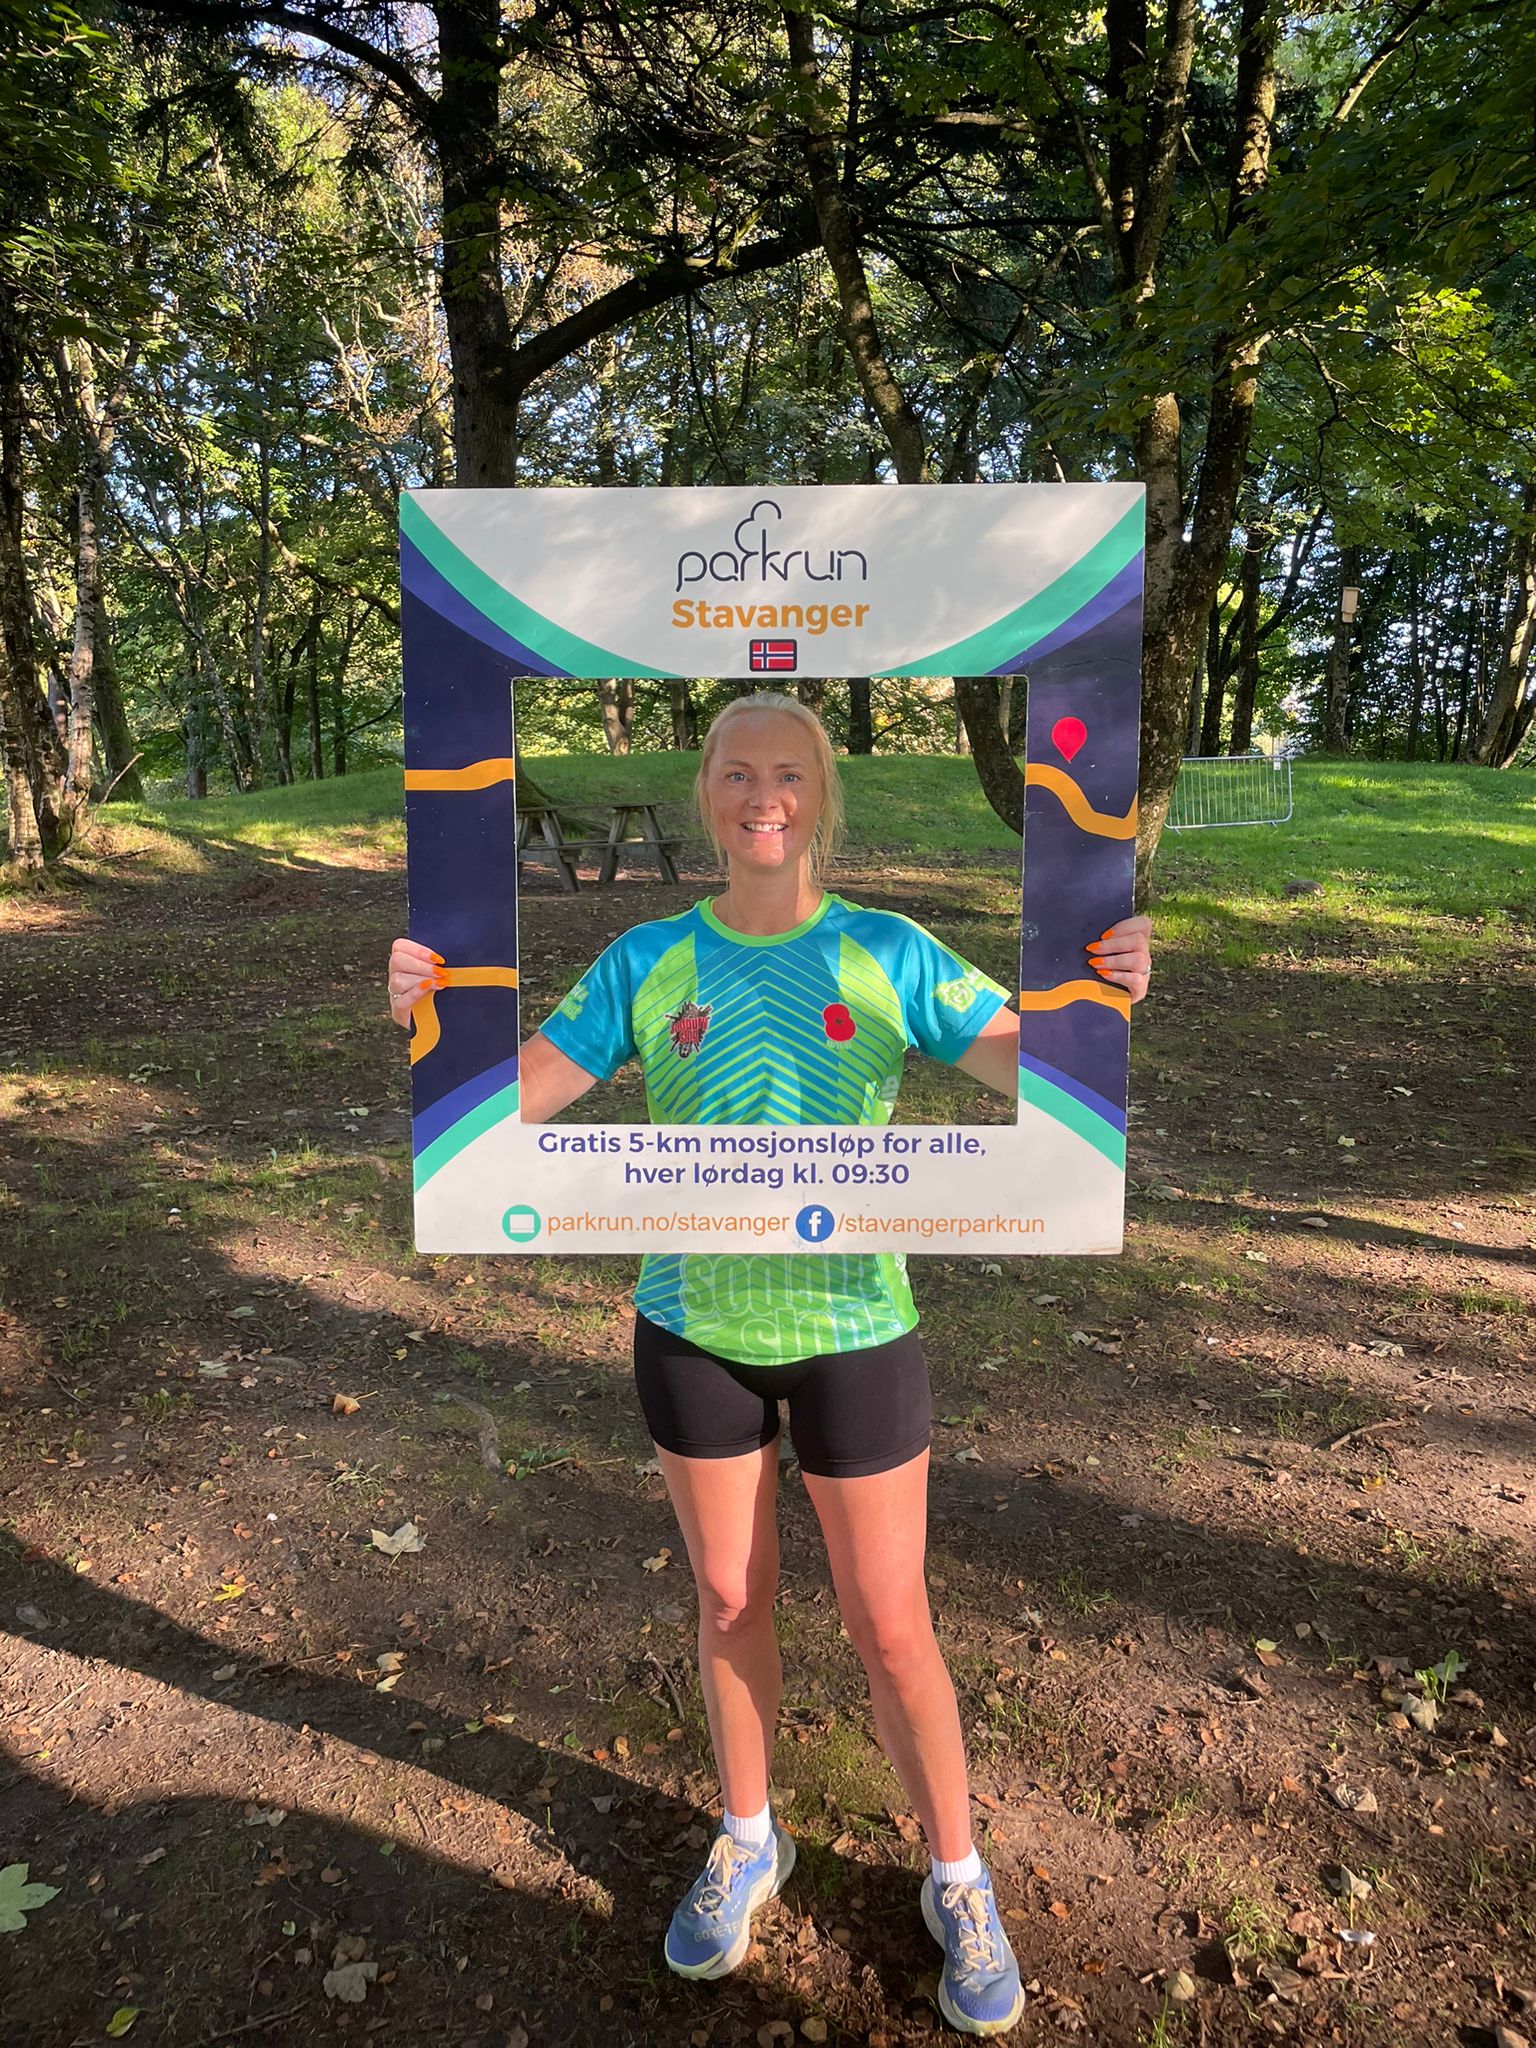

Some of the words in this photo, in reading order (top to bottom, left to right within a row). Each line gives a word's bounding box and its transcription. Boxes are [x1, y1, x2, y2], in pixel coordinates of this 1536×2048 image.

[675, 528, 868, 592] parkrun
[671, 598, 870, 636] Stavanger
[537, 1130, 622, 1154] Gratis
[628, 1131, 701, 1154] 5-km
[709, 1130, 875, 1158] mosjonsløp
[882, 1132, 922, 1154] for
[928, 1132, 987, 1157] alle,
[625, 1162, 686, 1184] hver
[694, 1162, 784, 1189] lørdag
[792, 1162, 824, 1184] kl.
[831, 1163, 910, 1185] 09:30
[547, 1211, 791, 1237] parkrun.no/stavanger
[836, 1212, 1046, 1239] /stavangerparkrun
